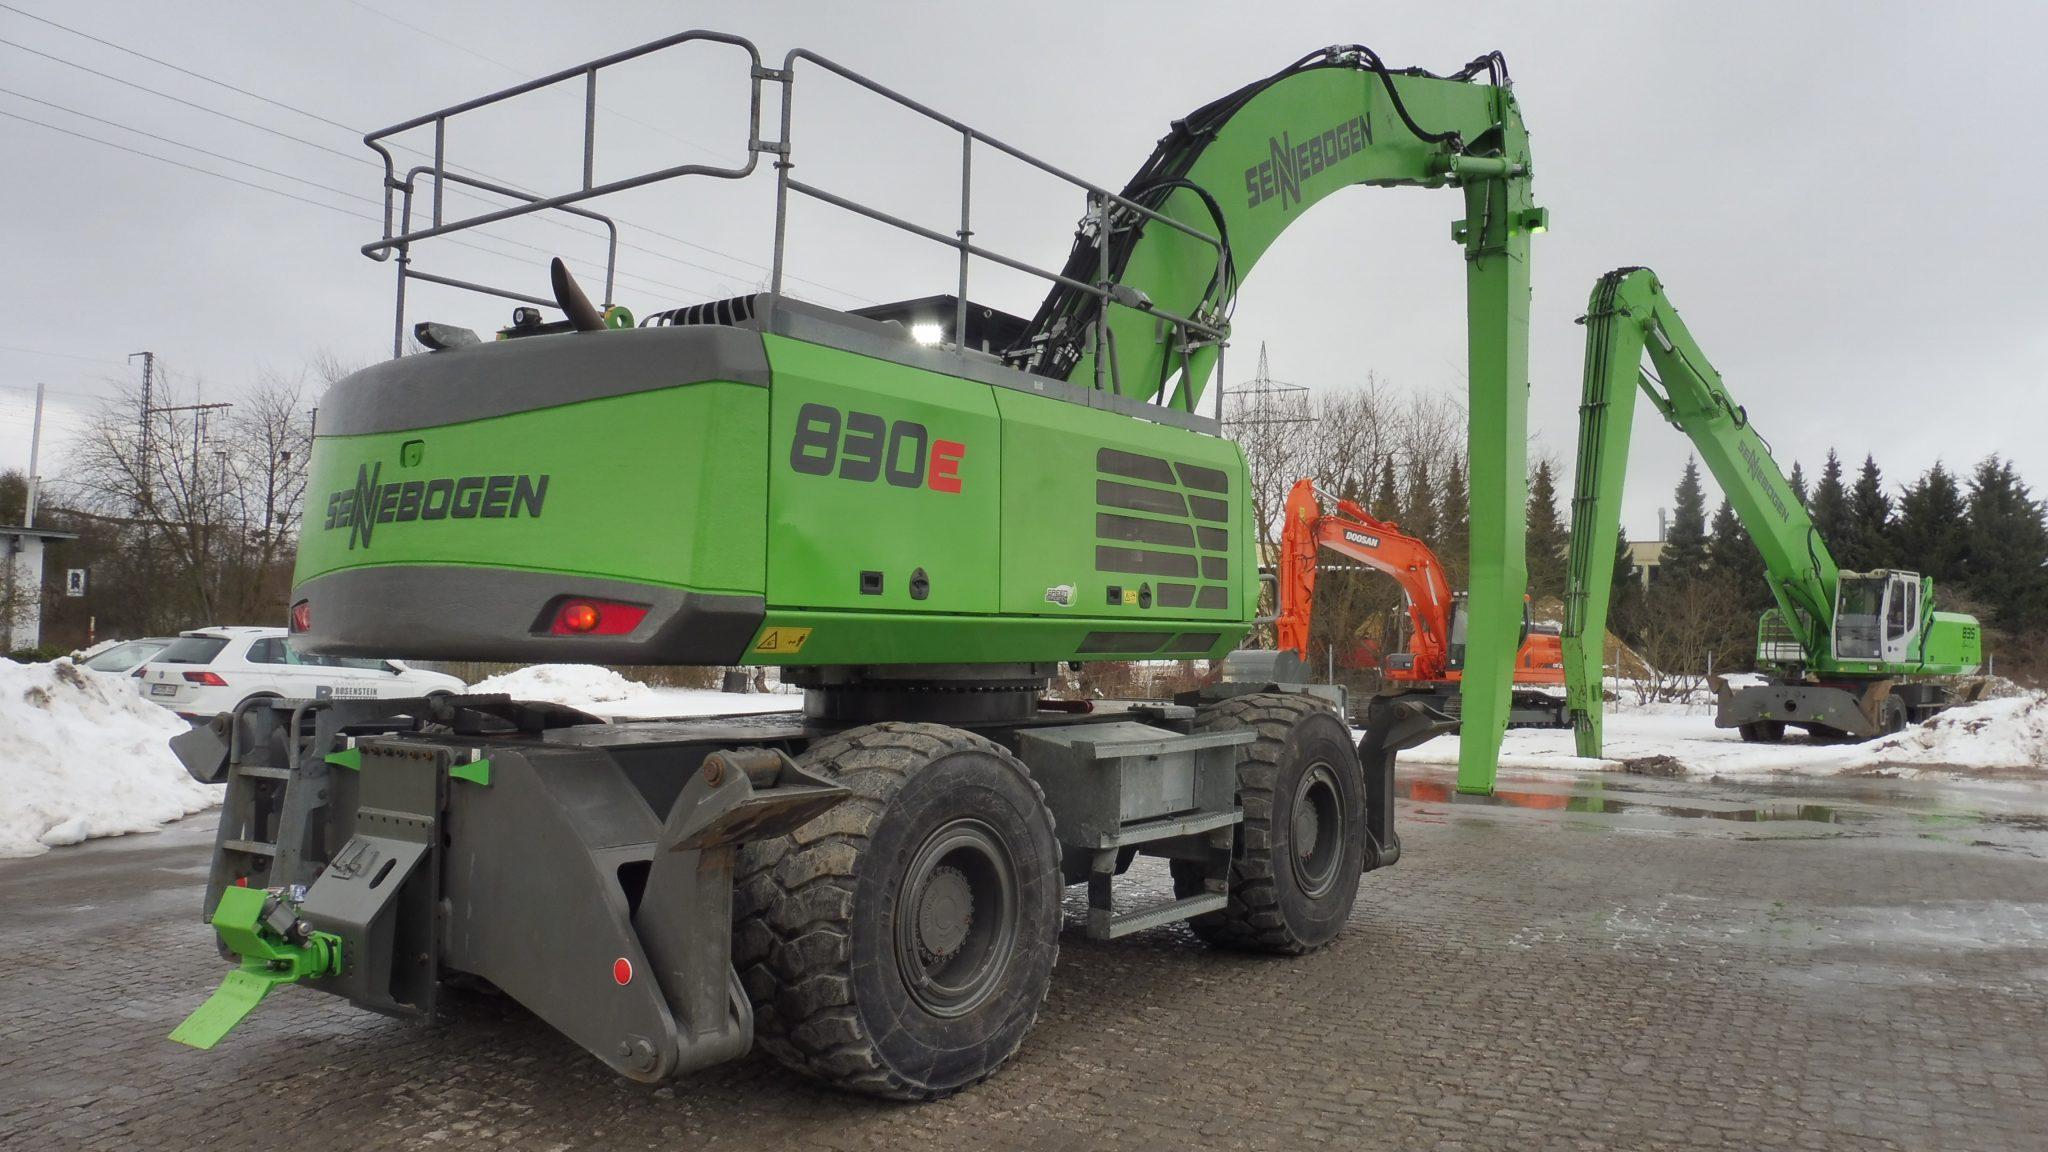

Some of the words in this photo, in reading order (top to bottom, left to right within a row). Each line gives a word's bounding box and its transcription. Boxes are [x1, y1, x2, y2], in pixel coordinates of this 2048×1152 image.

[1244, 111, 1374, 211] SENNEBOGEN
[324, 461, 550, 551] SENNEBOGEN
[1738, 439, 1789, 524] SENNEBOGEN
[1345, 531, 1378, 547] DOOSAN
[335, 687, 378, 696] ROSENSTEIN
